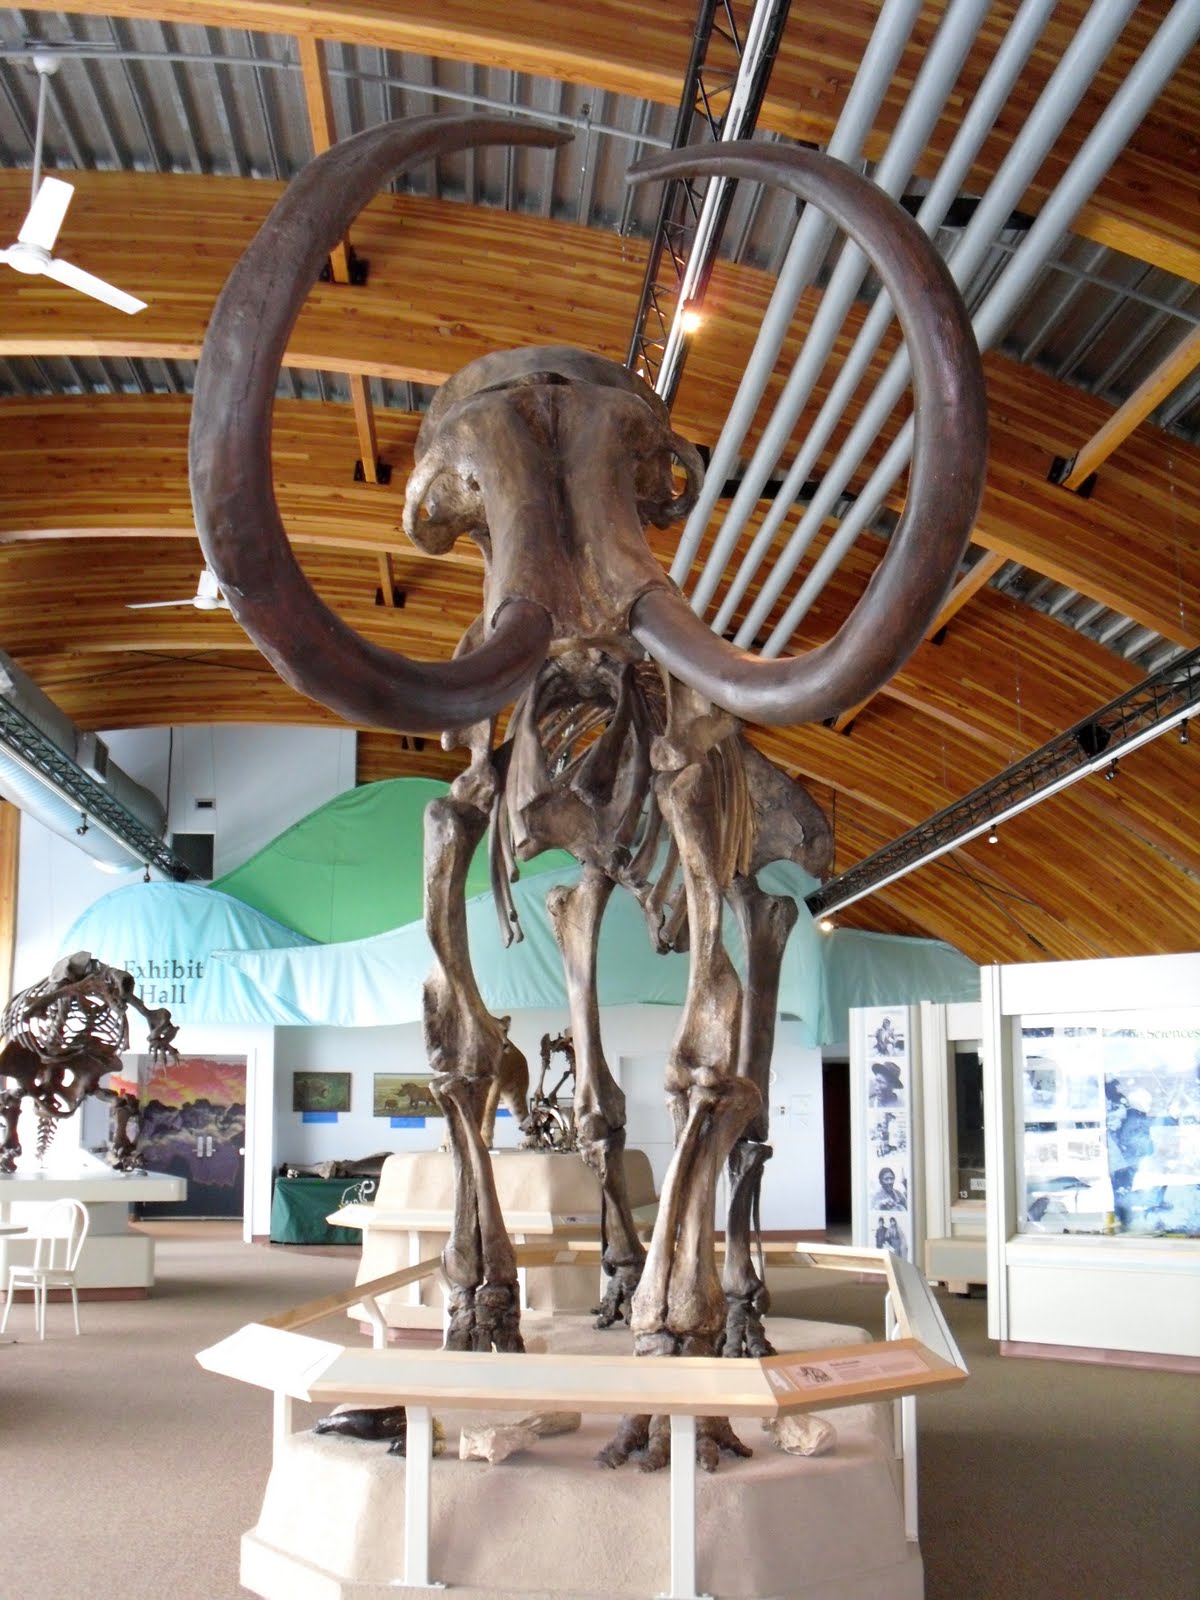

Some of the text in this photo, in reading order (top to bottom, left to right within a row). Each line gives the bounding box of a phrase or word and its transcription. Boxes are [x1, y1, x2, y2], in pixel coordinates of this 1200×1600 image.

[124, 959, 204, 979] Exhibit
[139, 984, 186, 1004] Hall
[1146, 1027, 1200, 1040] Sciences
